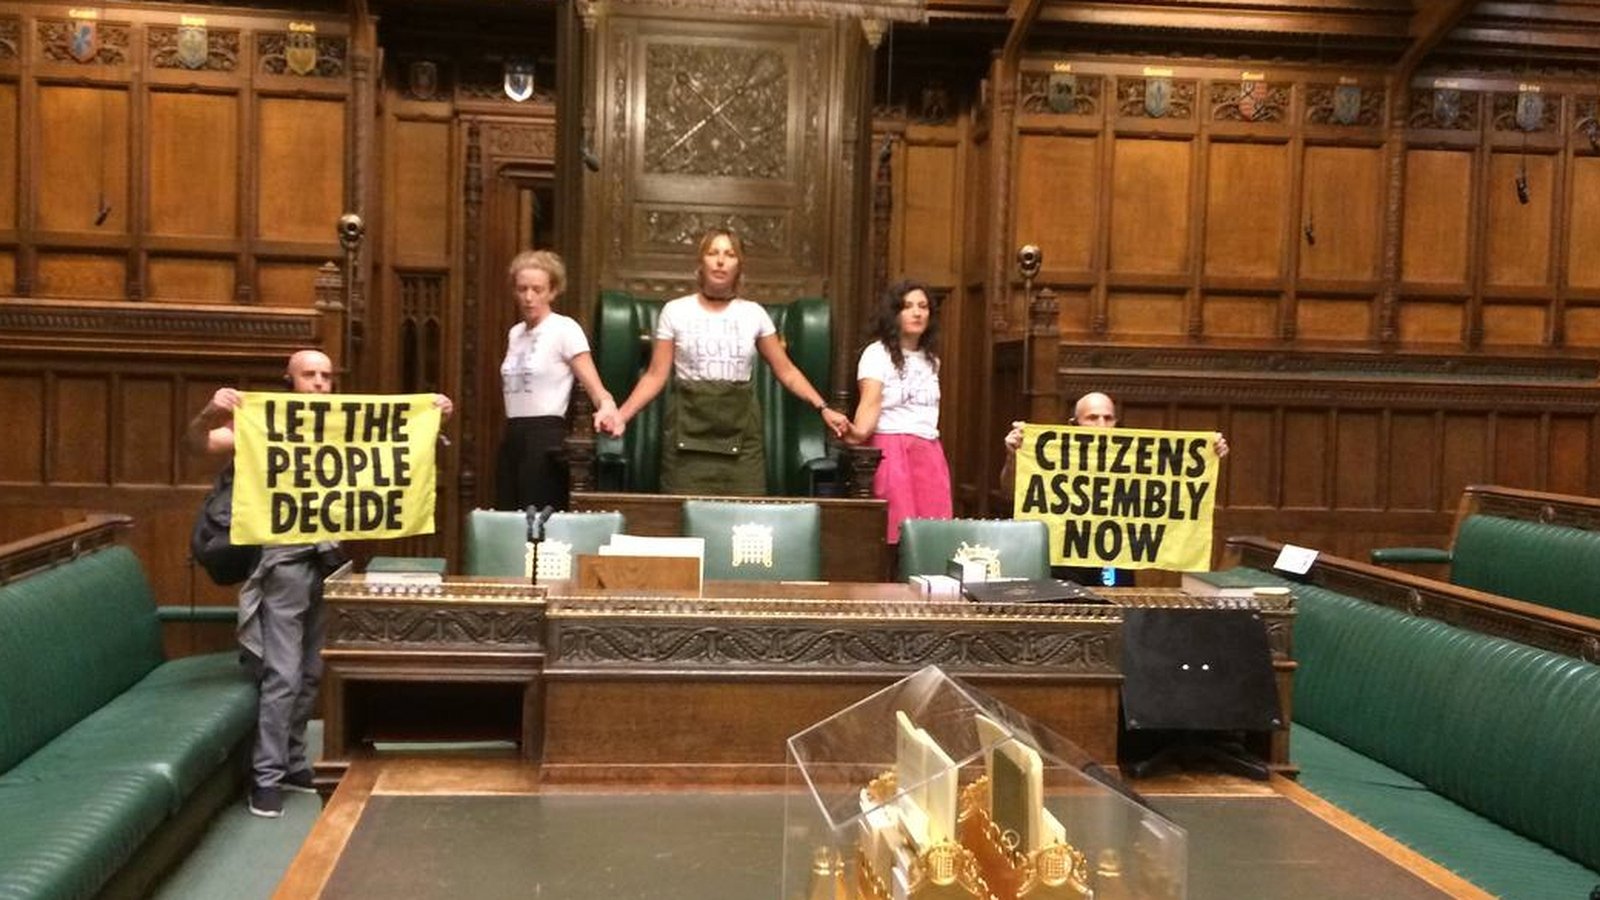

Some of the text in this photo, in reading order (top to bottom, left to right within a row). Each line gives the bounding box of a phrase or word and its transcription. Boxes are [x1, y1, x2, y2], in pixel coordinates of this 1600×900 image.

[266, 400, 411, 442] LET THE
[266, 445, 411, 488] PEOPLE
[1035, 431, 1207, 478] CITIZENS
[271, 490, 403, 534] DECIDE
[1022, 474, 1209, 520] ASSEMBLY
[1063, 520, 1167, 563] NOW
